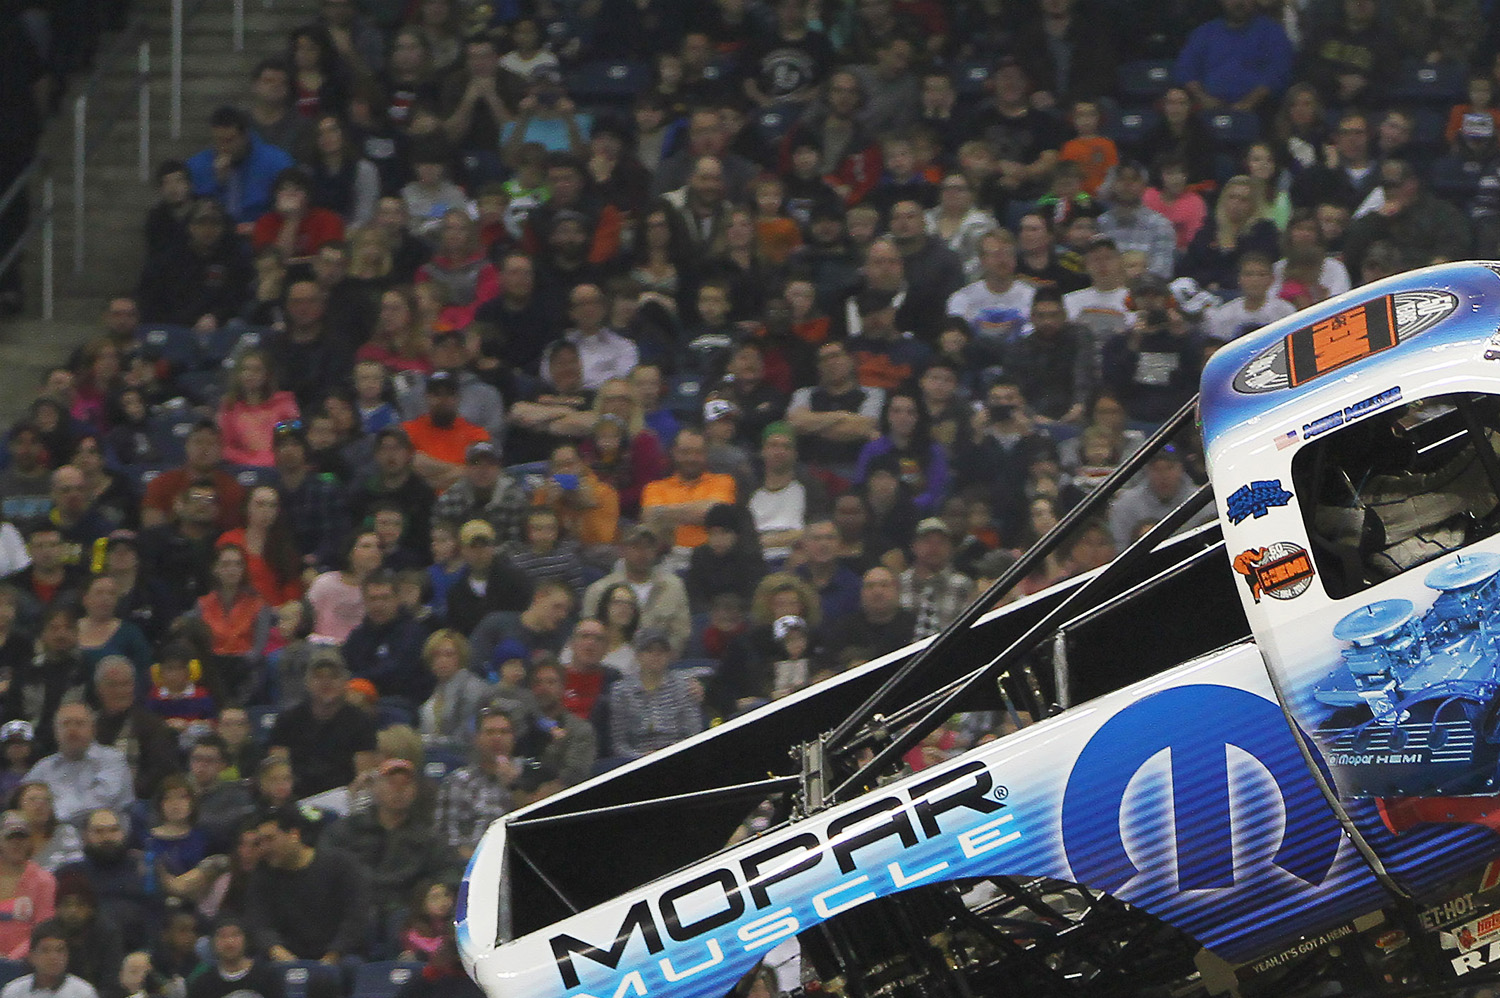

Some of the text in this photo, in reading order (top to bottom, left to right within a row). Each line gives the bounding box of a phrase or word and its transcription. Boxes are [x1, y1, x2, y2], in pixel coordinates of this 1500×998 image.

[1339, 754, 1422, 766] Mopar HEMI
[1299, 940, 1318, 954] GOT
[1319, 936, 1328, 945] A
